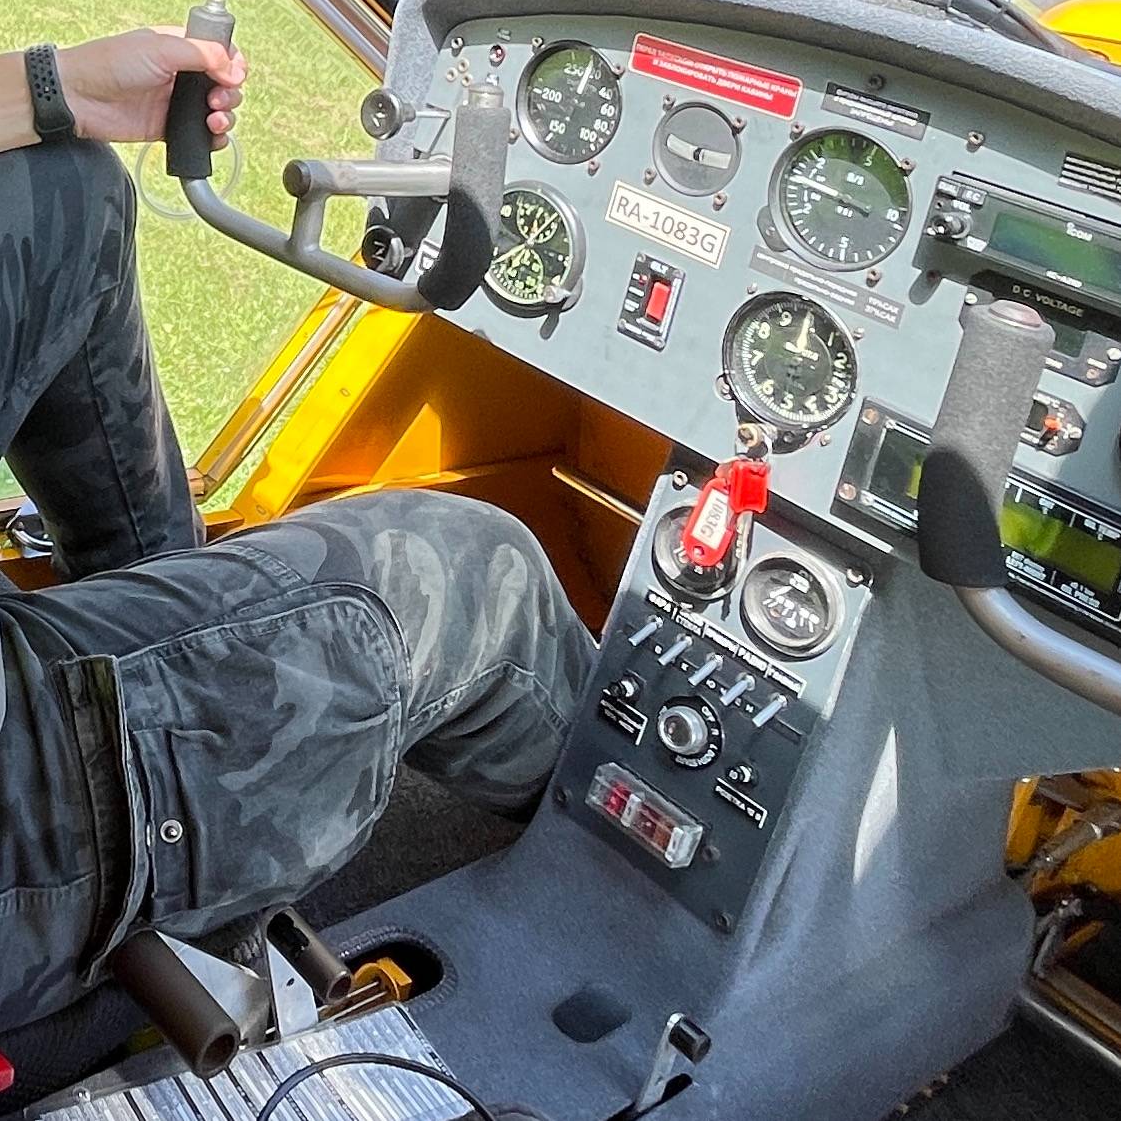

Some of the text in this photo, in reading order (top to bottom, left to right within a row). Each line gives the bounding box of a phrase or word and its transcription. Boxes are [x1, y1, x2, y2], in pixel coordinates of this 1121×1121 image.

[541, 87, 562, 103] 200
[598, 86, 613, 100] 40
[600, 103, 615, 117] 60
[549, 119, 566, 134] 150
[594, 118, 608, 132] 80
[579, 127, 597, 142] 100
[815, 157, 826, 169] 2
[863, 156, 873, 167] 5
[802, 203, 812, 214] 2
[886, 208, 899, 222] 10
[616, 195, 718, 253] RA-1083G
[839, 236, 849, 248] 5
[1035, 293, 1085, 318] VOLTAGE
[779, 311, 792, 326] 9
[758, 321, 771, 339] 8
[751, 349, 764, 366] 7
[833, 352, 848, 369] 2
[762, 379, 774, 395] 6
[824, 385, 838, 404] 3
[780, 393, 794, 410] 5
[700, 497, 727, 538] 1083G
